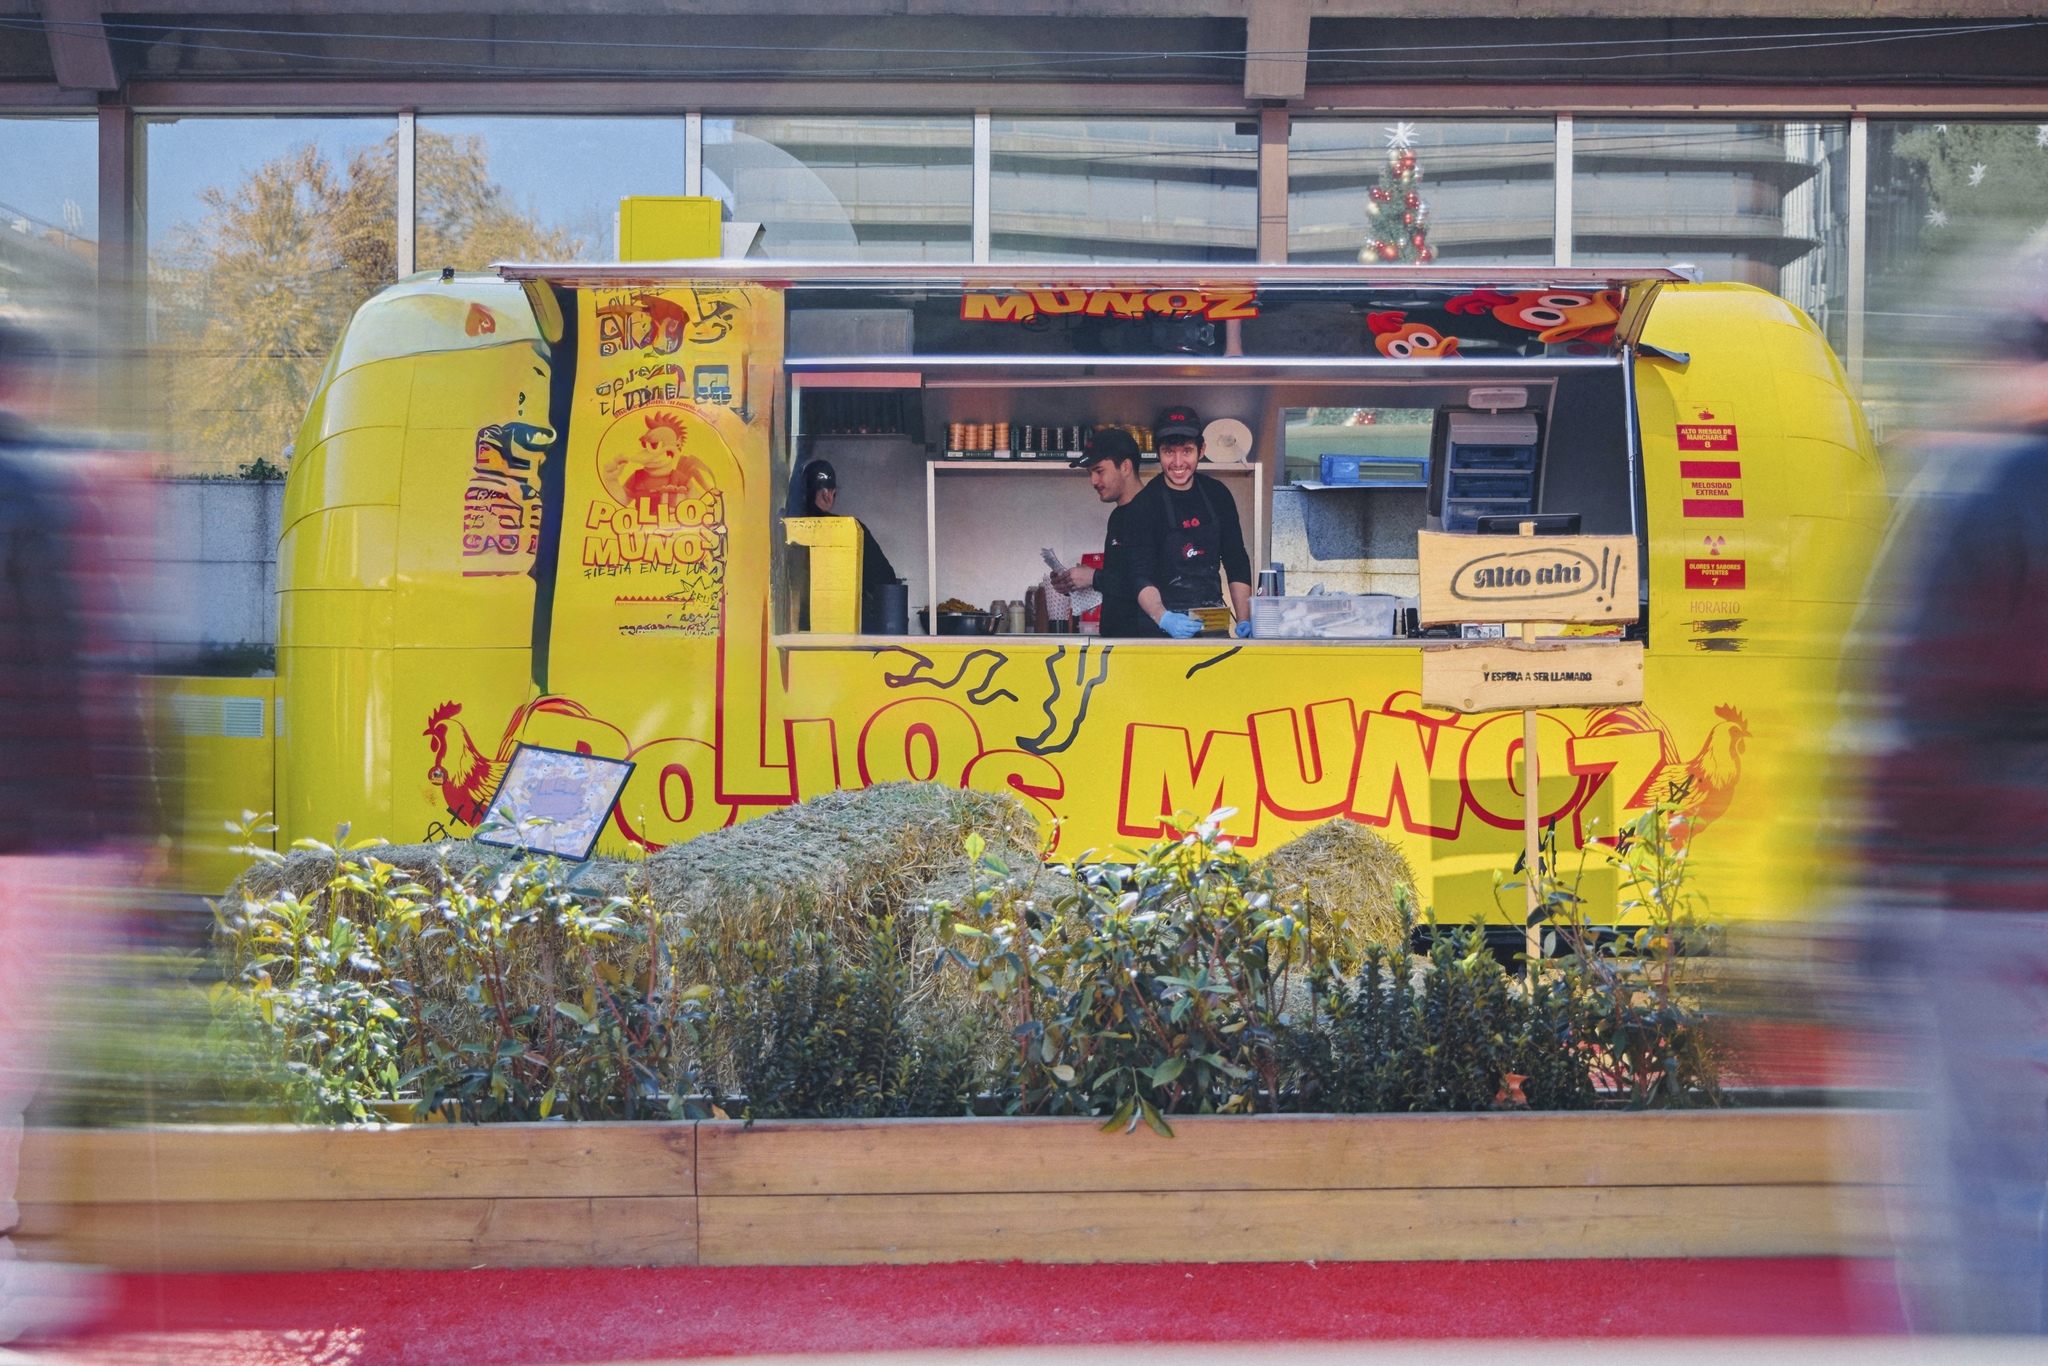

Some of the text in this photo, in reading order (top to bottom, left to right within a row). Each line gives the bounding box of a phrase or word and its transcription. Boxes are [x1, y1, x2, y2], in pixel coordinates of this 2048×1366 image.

[1704, 441, 1711, 449] 8
[1691, 481, 1732, 489] MELOSIDAD
[1473, 566, 1531, 589] Alto
[1535, 561, 1582, 584] ahí
[1712, 577, 1719, 586] 7
[1690, 601, 1741, 614] HORARIO
[1483, 671, 1592, 682] Y ESPERA A SER LLAMADO
[1117, 690, 1668, 852] MUÑOZ
